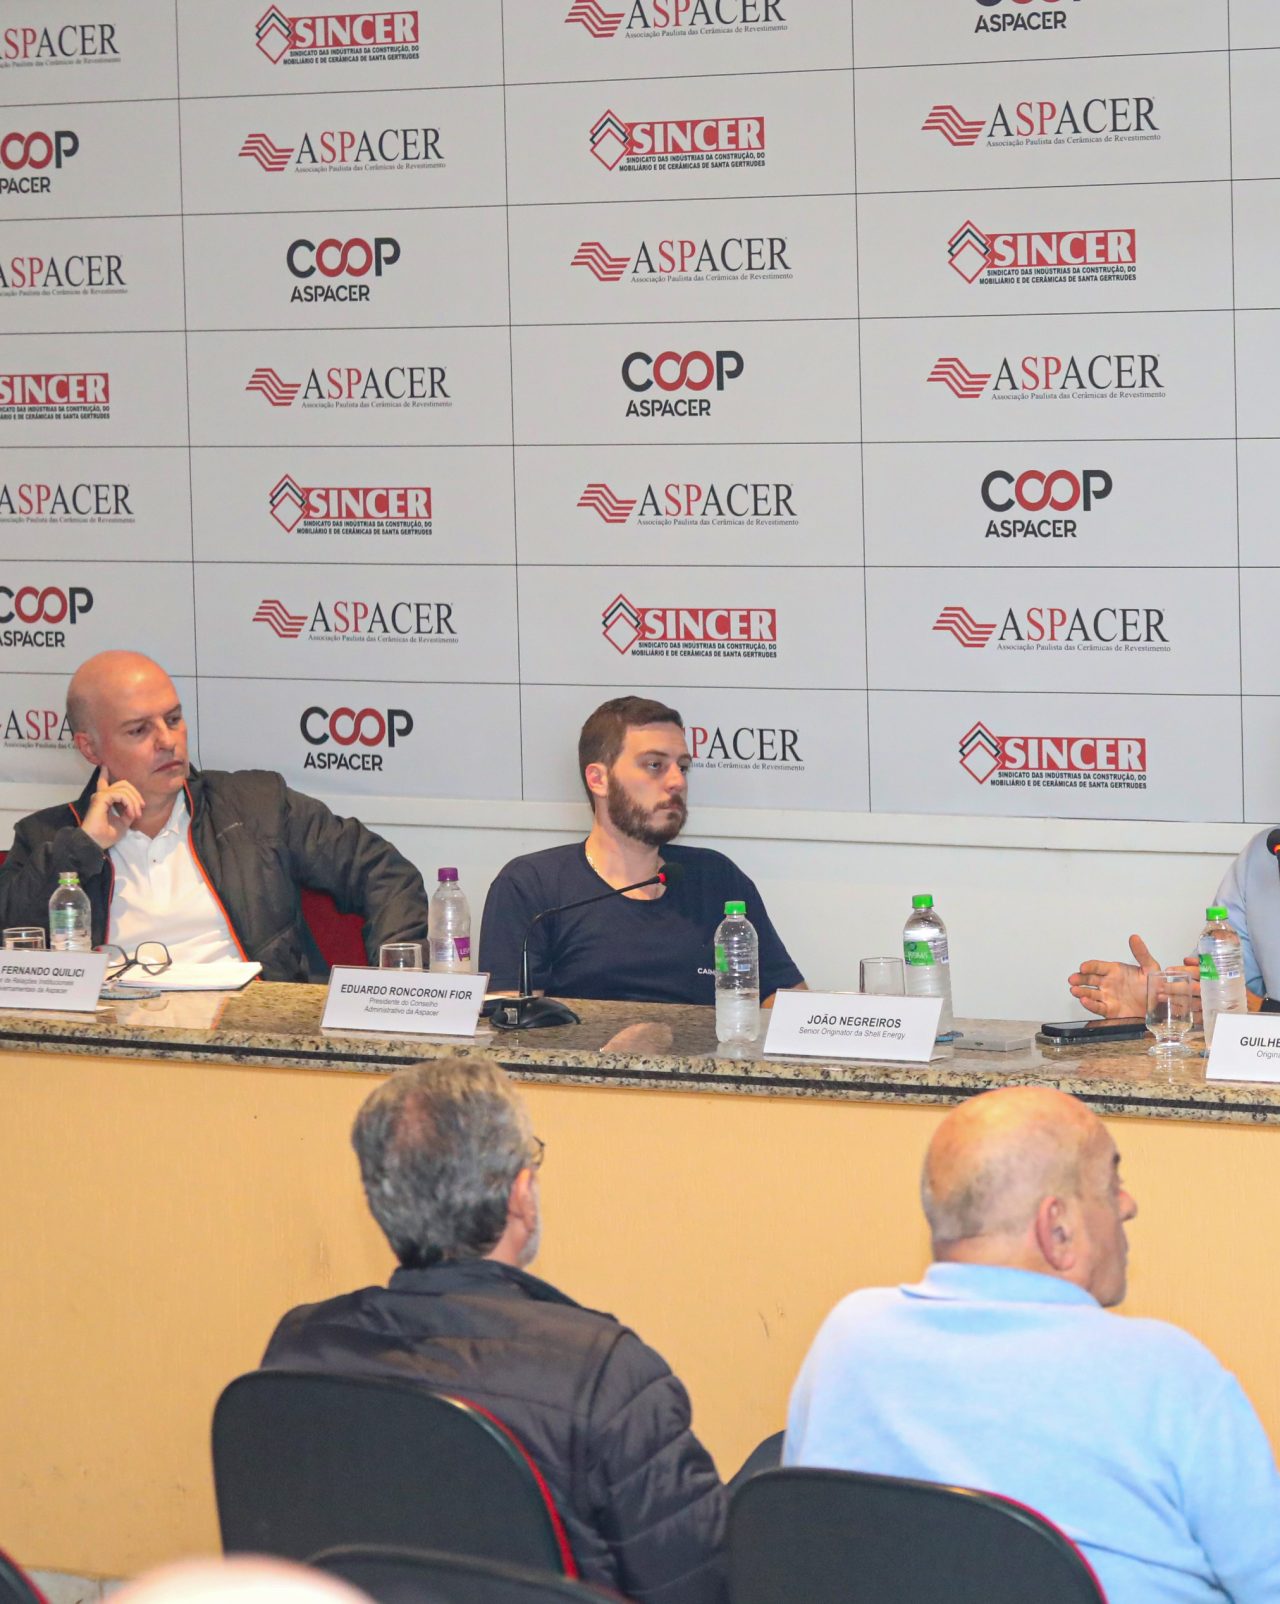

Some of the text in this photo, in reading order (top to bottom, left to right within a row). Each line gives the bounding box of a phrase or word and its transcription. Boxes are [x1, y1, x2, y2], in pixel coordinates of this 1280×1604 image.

[295, 12, 416, 47] SINCER
[974, 12, 1067, 32] ASPACER
[0, 24, 119, 58] SPACER
[633, 118, 762, 149] SINCER
[986, 98, 1158, 139] ASPACER
[0, 131, 79, 168] OOP
[295, 129, 444, 164] ASPACER
[0, 177, 51, 194] PACER
[287, 237, 400, 277] COOP
[633, 238, 790, 274] ASPACER
[994, 230, 1132, 264] SINCER
[290, 285, 370, 303] ASPACER
[302, 367, 449, 399] ASPACER
[621, 351, 743, 392] COOP
[992, 355, 1165, 390] ASPACER
[0, 375, 106, 403] SINCER
[625, 400, 710, 416] ASPACER
[306, 488, 428, 517] SINCER
[638, 483, 797, 517] ASPACER
[981, 470, 1112, 512] COOP
[985, 519, 1077, 538] ASPACER
[309, 603, 457, 634] ASPACER
[643, 609, 774, 641] SINCER
[998, 608, 1169, 643] ASPACER
[4, 709, 74, 741] ASPA
[300, 707, 413, 748] COOP
[686, 727, 803, 761] PACER
[1004, 738, 1143, 770] SINCER
[303, 753, 383, 771] ASPACER
[1, 966, 85, 977] FERNANDO QUILICI
[340, 984, 472, 1000] EDUARDO RONCORONI FIOR
[369, 998, 400, 1006] Presidente
[410, 999, 438, 1007] Conselho
[415, 1009, 439, 1017] Aspacer
[807, 1014, 902, 1028] JOÃO NEGREIROS
[799, 1027, 819, 1035] Senior
[822, 1028, 852, 1037] Originator
[864, 1030, 880, 1038] Shell
[882, 1031, 905, 1040] Energy
